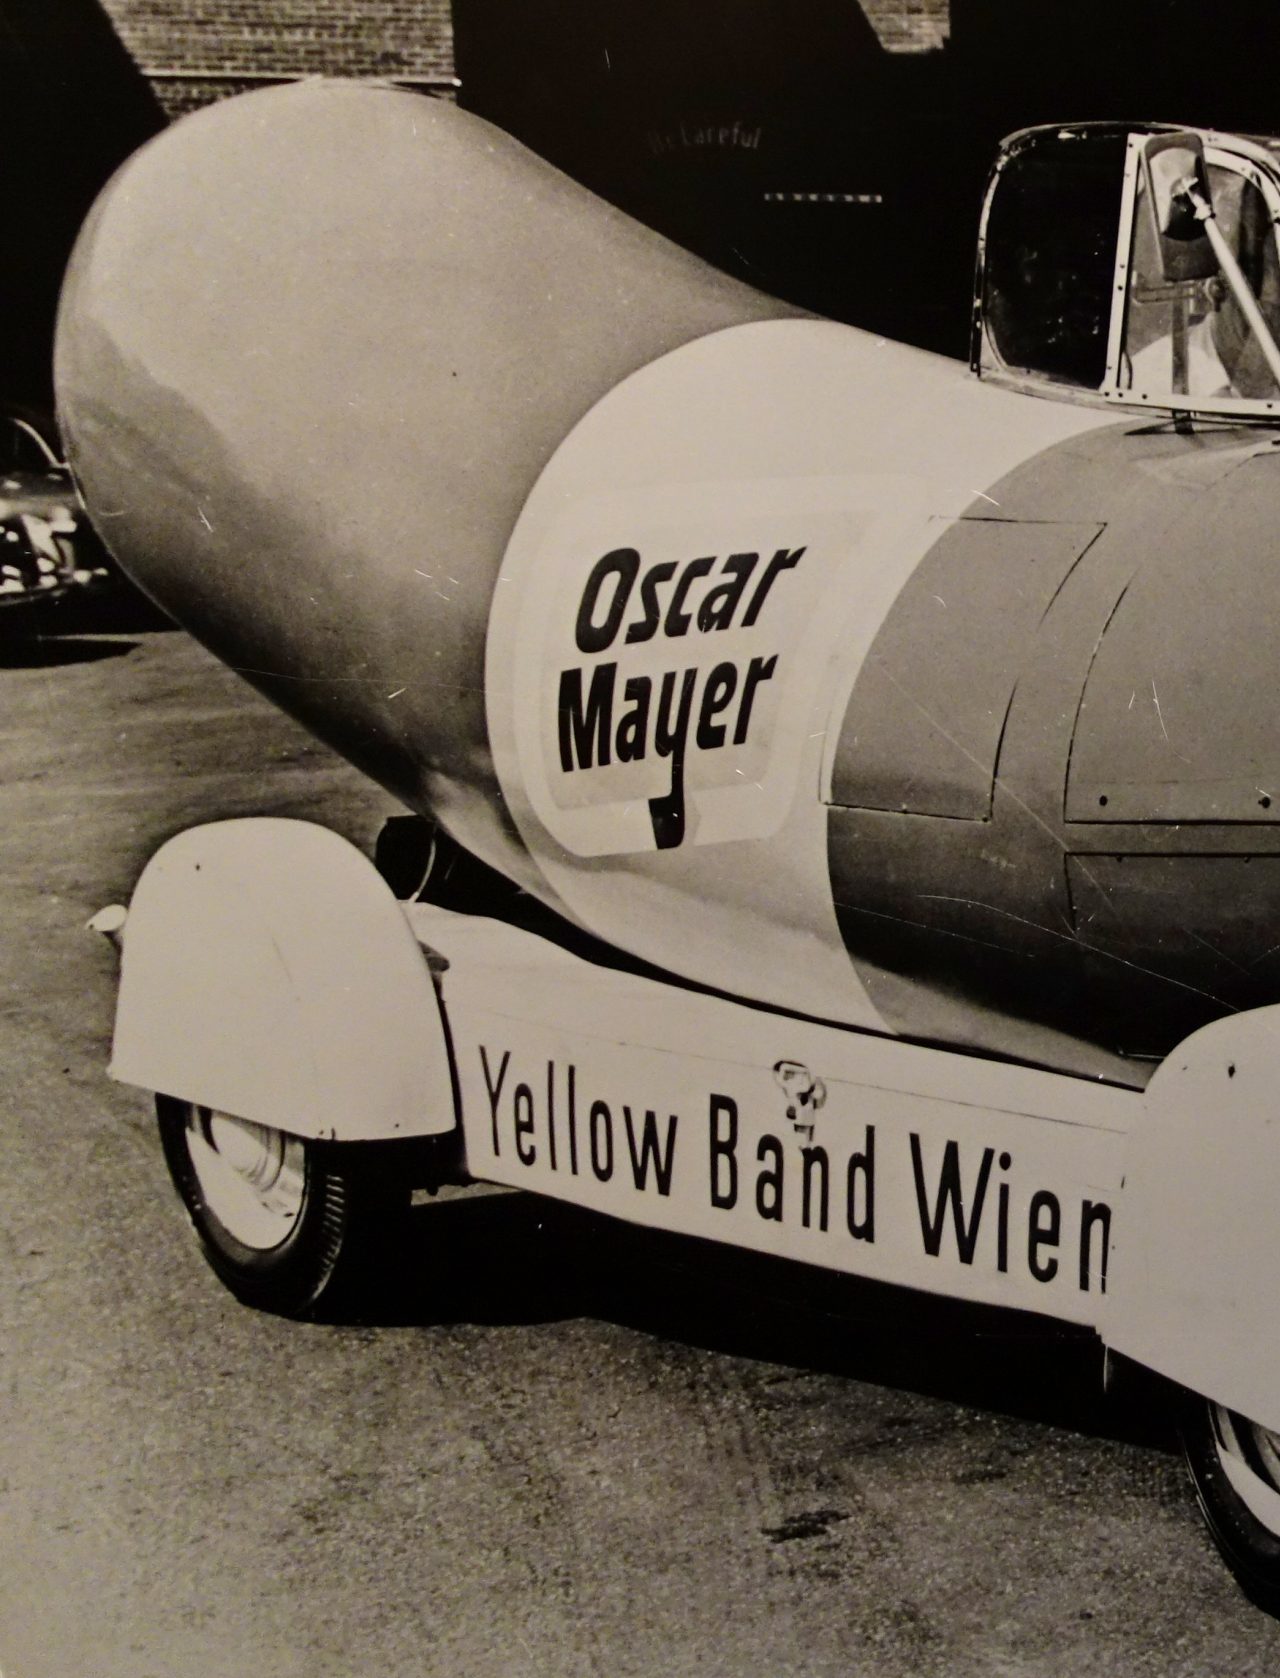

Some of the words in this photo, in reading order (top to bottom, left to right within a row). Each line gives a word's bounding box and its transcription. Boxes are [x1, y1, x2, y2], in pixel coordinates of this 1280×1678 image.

[575, 546, 808, 654] Oscar
[557, 654, 779, 850] Mayer
[478, 1044, 679, 1197] Yellow
[708, 1092, 876, 1244] Band
[908, 1131, 1113, 1295] Wien
